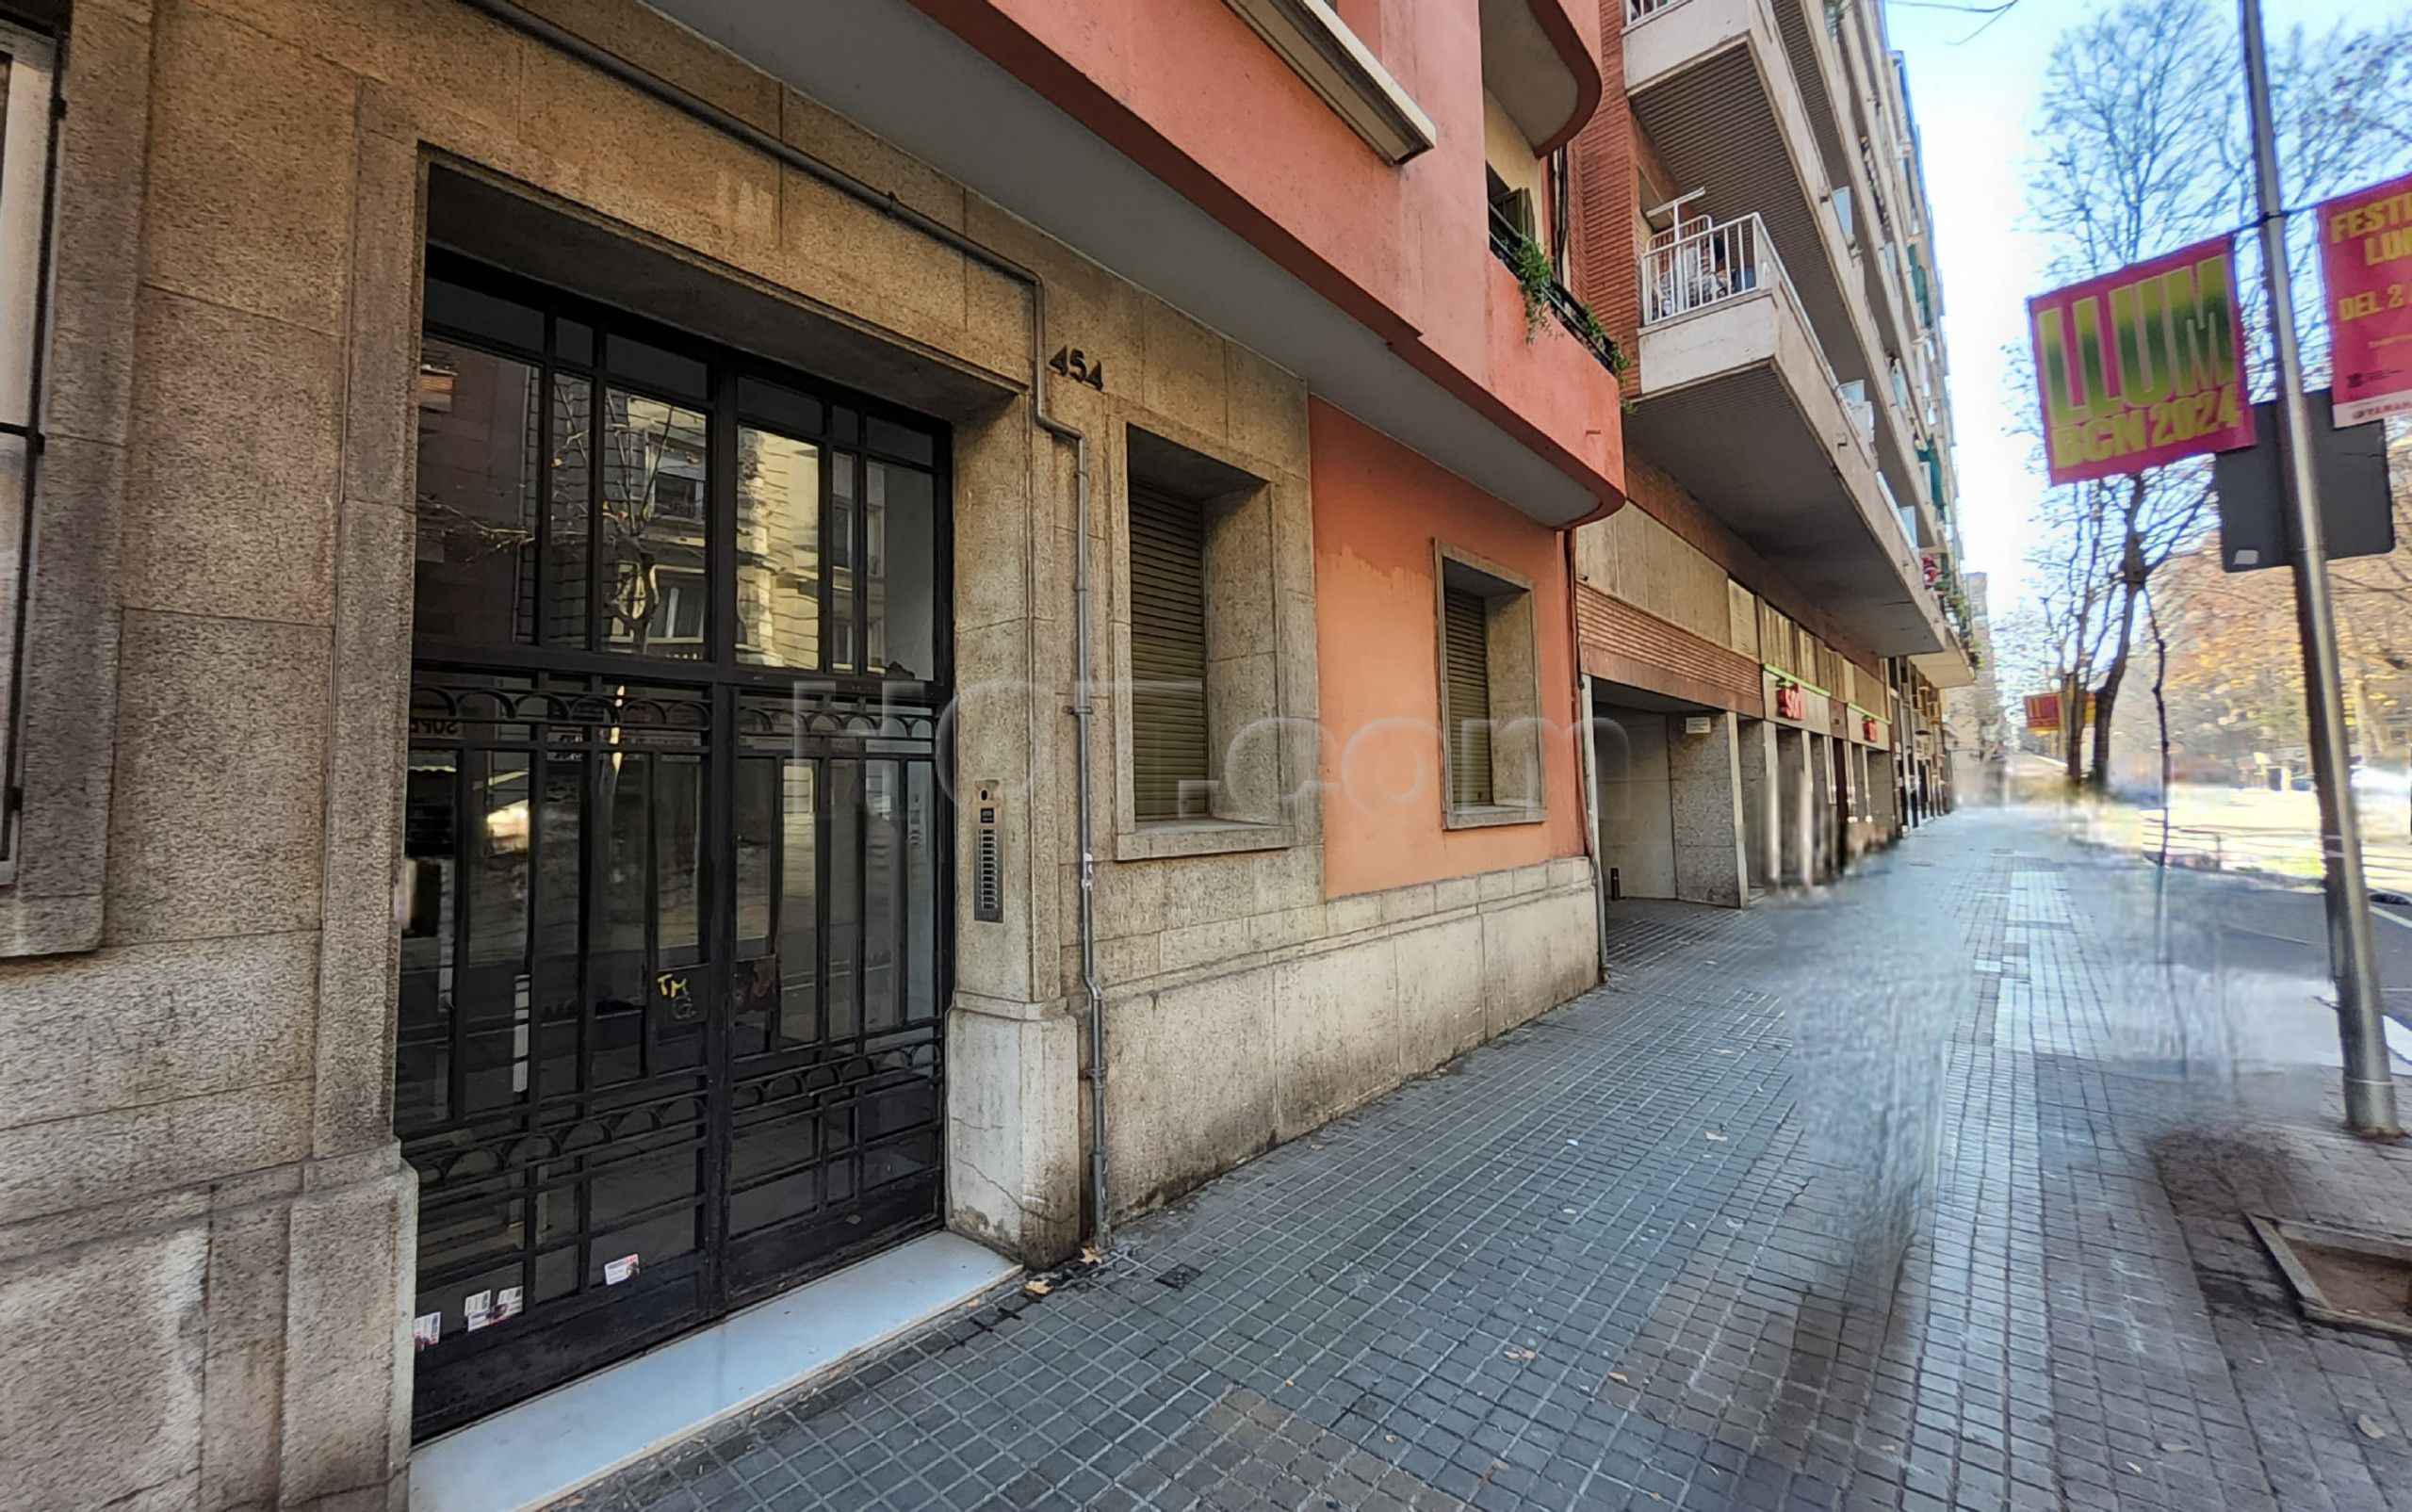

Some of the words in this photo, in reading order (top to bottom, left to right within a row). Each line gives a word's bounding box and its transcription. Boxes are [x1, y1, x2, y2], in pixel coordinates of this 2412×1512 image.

[2339, 291, 2385, 321] DEL
[1049, 345, 1103, 391] 454
[2036, 252, 2239, 427] LLUM
[2052, 408, 2148, 469] BCN
[2151, 383, 2241, 447] 2024
